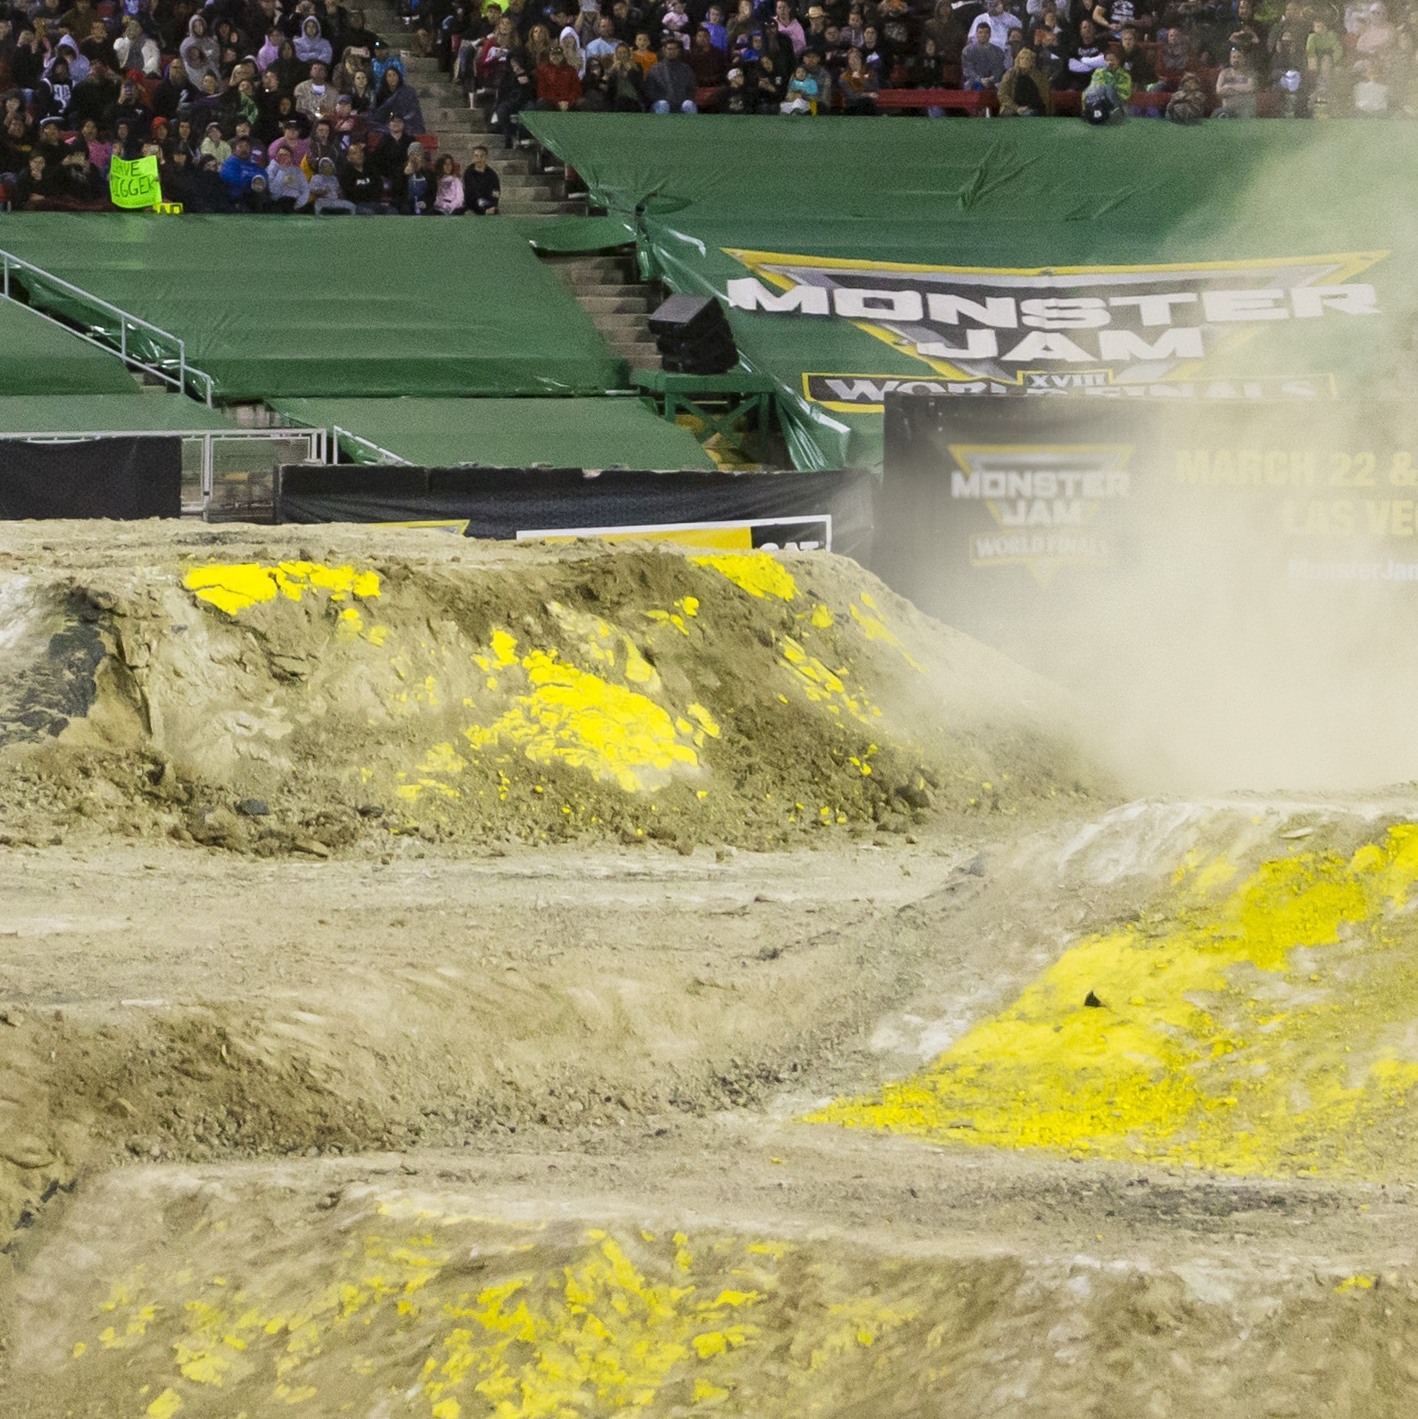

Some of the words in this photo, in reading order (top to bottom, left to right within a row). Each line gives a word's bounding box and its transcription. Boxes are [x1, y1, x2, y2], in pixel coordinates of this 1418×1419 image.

[727, 277, 1381, 330] MONSTER
[916, 326, 1204, 362] JAM
[824, 379, 1069, 401] WOR
[1030, 373, 1105, 389] XVIII
[950, 469, 1131, 499] MONSTER
[1176, 450, 1316, 486] MARCH
[1328, 451, 1377, 487] 22
[1389, 451, 1418, 487] &
[1001, 499, 1084, 526] JAM
[1282, 498, 1356, 538] LAS
